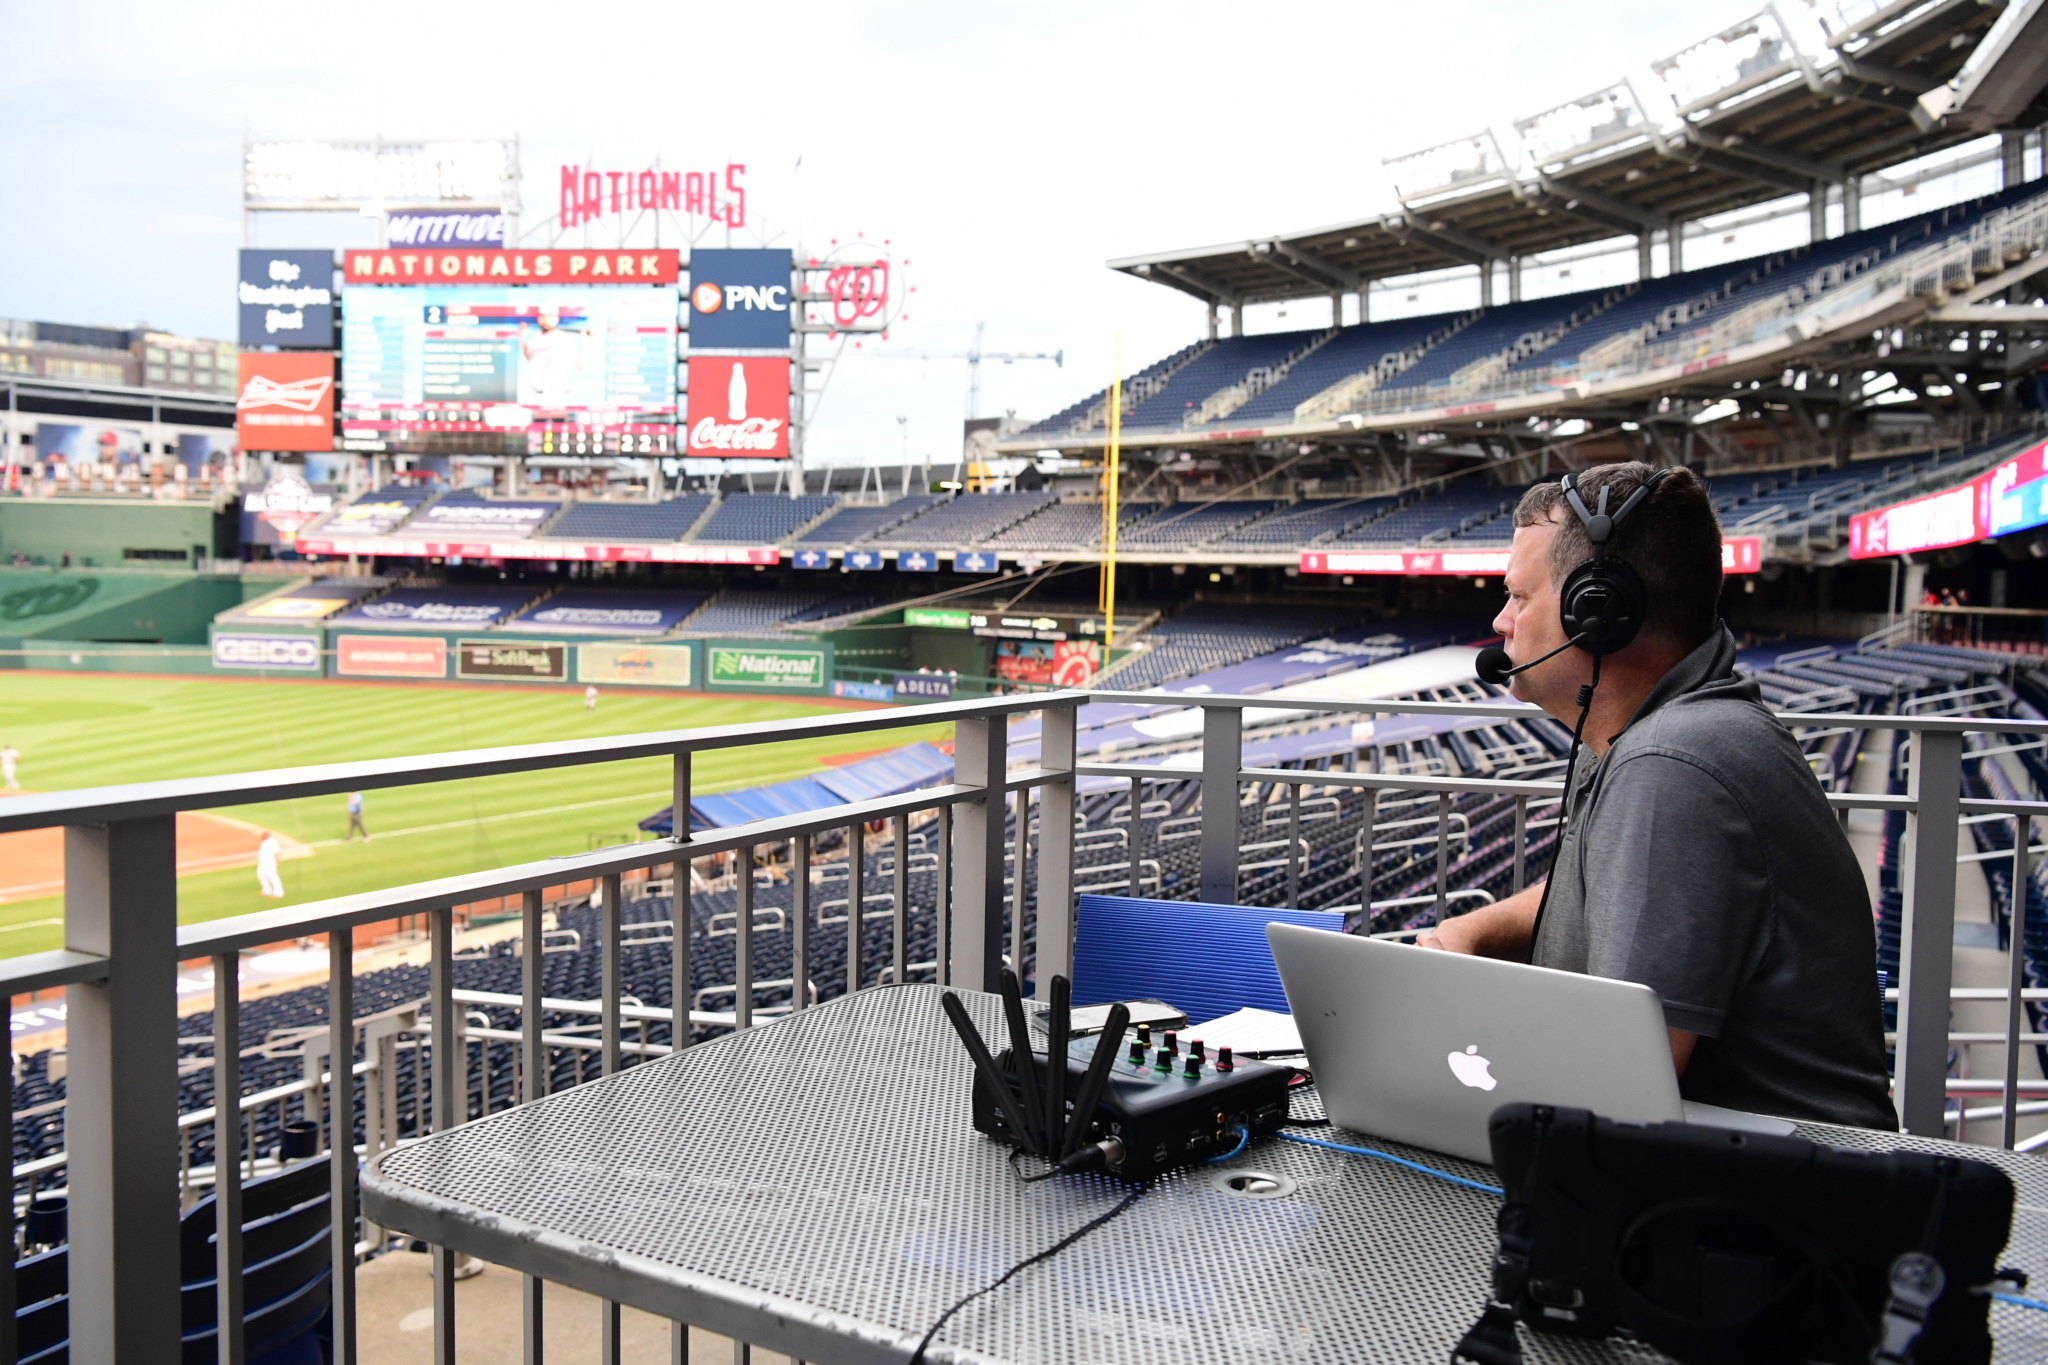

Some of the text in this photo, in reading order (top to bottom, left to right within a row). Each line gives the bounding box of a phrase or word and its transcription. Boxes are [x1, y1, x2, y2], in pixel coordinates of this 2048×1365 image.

[386, 214, 504, 245] NATITUDE
[353, 255, 660, 277] NATIONALS PARK
[724, 285, 788, 312] PNC
[621, 434, 667, 452] 2 2 1
[689, 416, 784, 451] Coca-Cola
[215, 638, 317, 664] GEICO
[737, 655, 816, 675] National
[908, 680, 950, 696] DELTA
